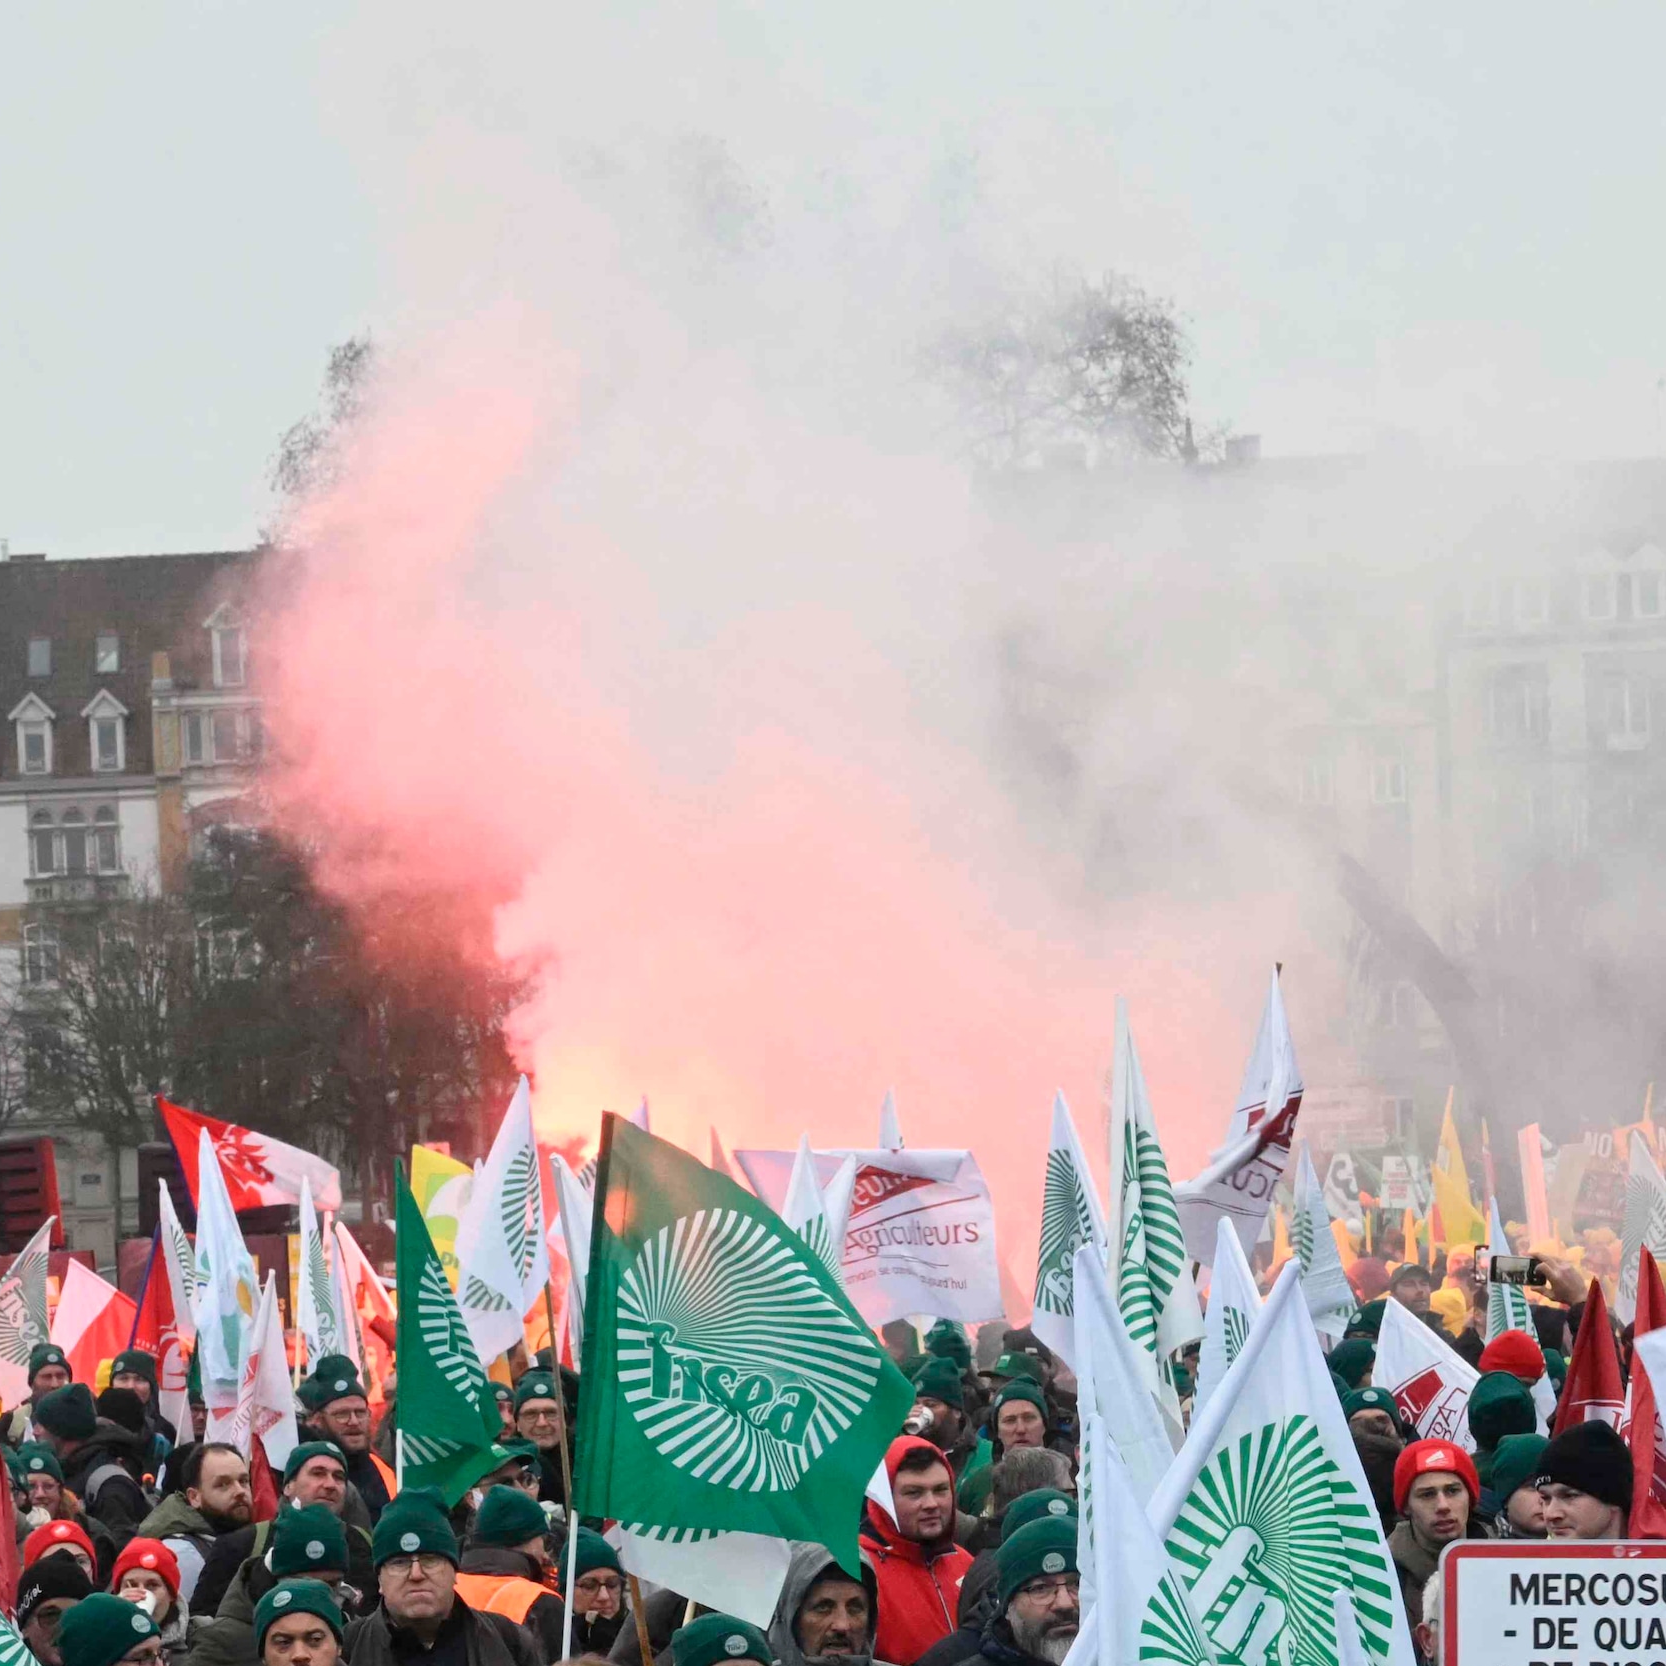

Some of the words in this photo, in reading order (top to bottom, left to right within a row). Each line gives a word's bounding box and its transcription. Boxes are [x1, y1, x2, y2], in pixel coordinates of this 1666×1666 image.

[1584, 1131, 1612, 1158] NO
[644, 1319, 817, 1447] fnsea
[1533, 1617, 1578, 1650] DE
